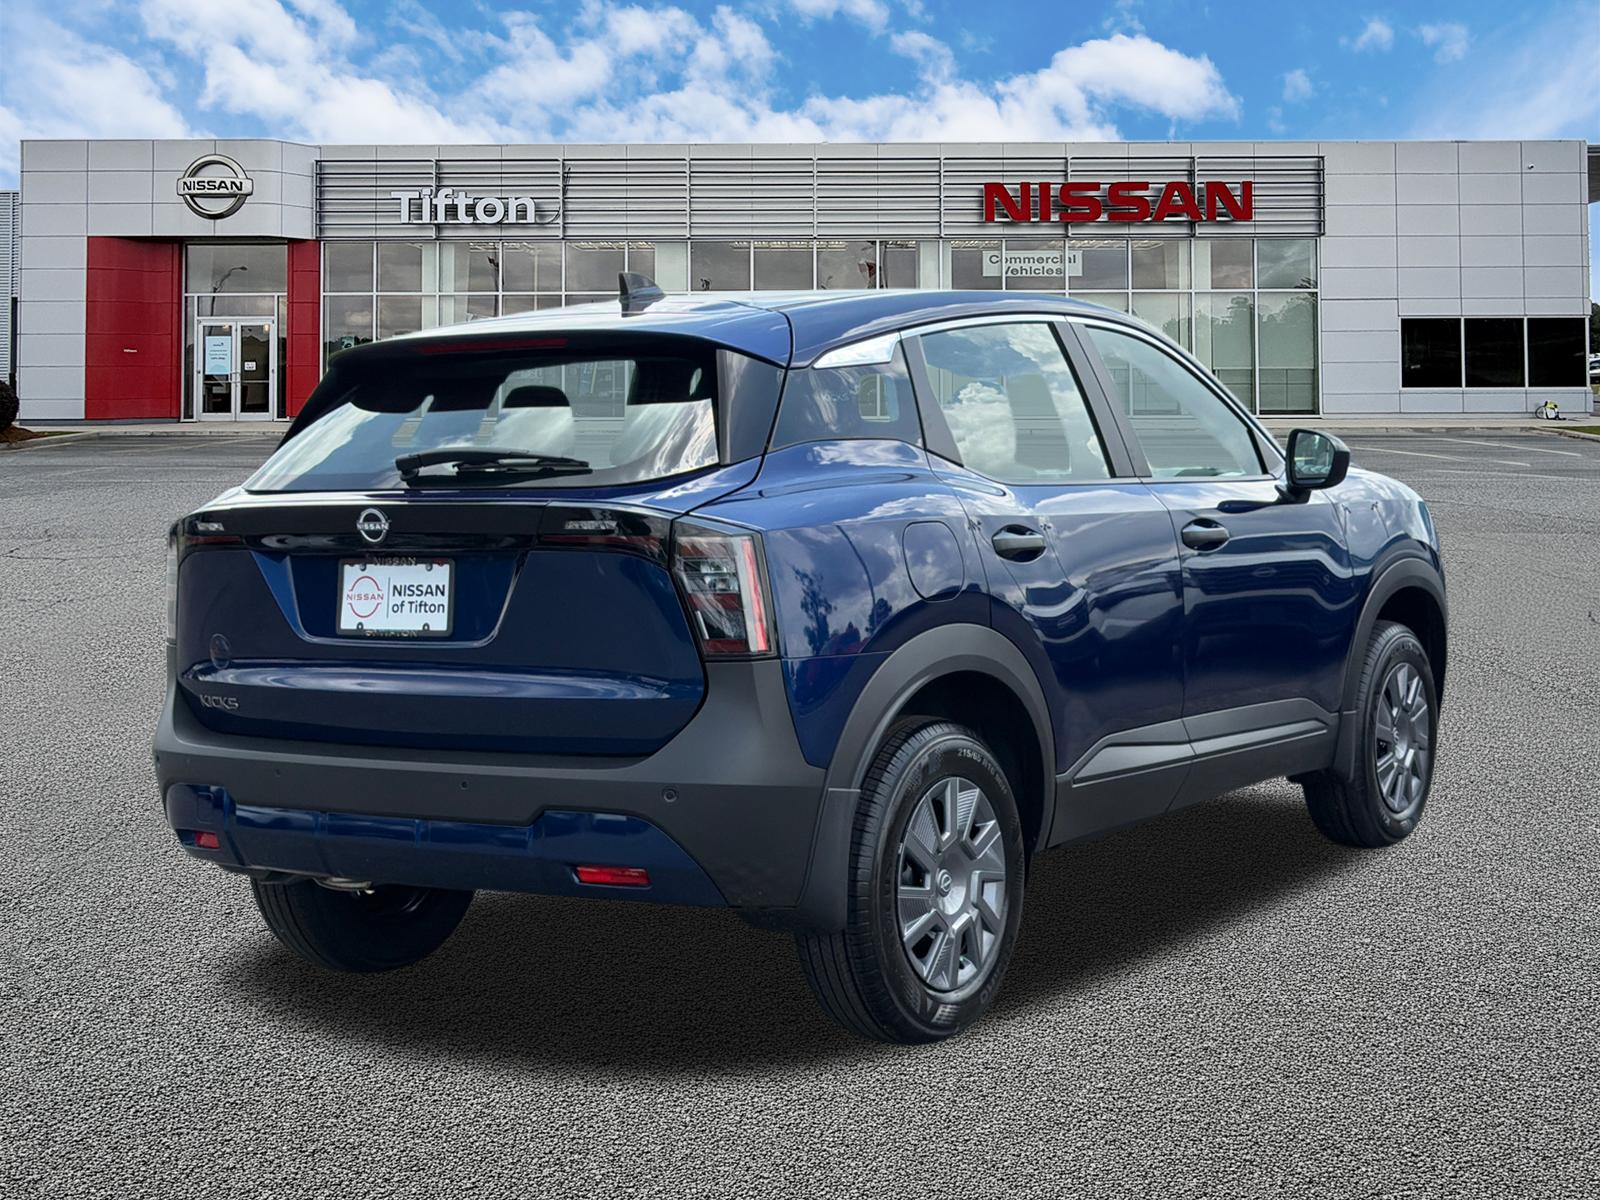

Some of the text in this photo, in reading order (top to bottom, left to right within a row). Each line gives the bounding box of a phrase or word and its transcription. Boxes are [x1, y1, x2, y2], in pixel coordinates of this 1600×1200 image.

[183, 180, 244, 192] NISSAN
[390, 187, 538, 225] Tifton
[983, 181, 1254, 223] NISSAN
[356, 521, 389, 530] NISSAN
[346, 593, 384, 601] NISSAN
[392, 584, 445, 597] NISSAN
[391, 601, 445, 614] of Tifton
[199, 694, 239, 710] KICKS
